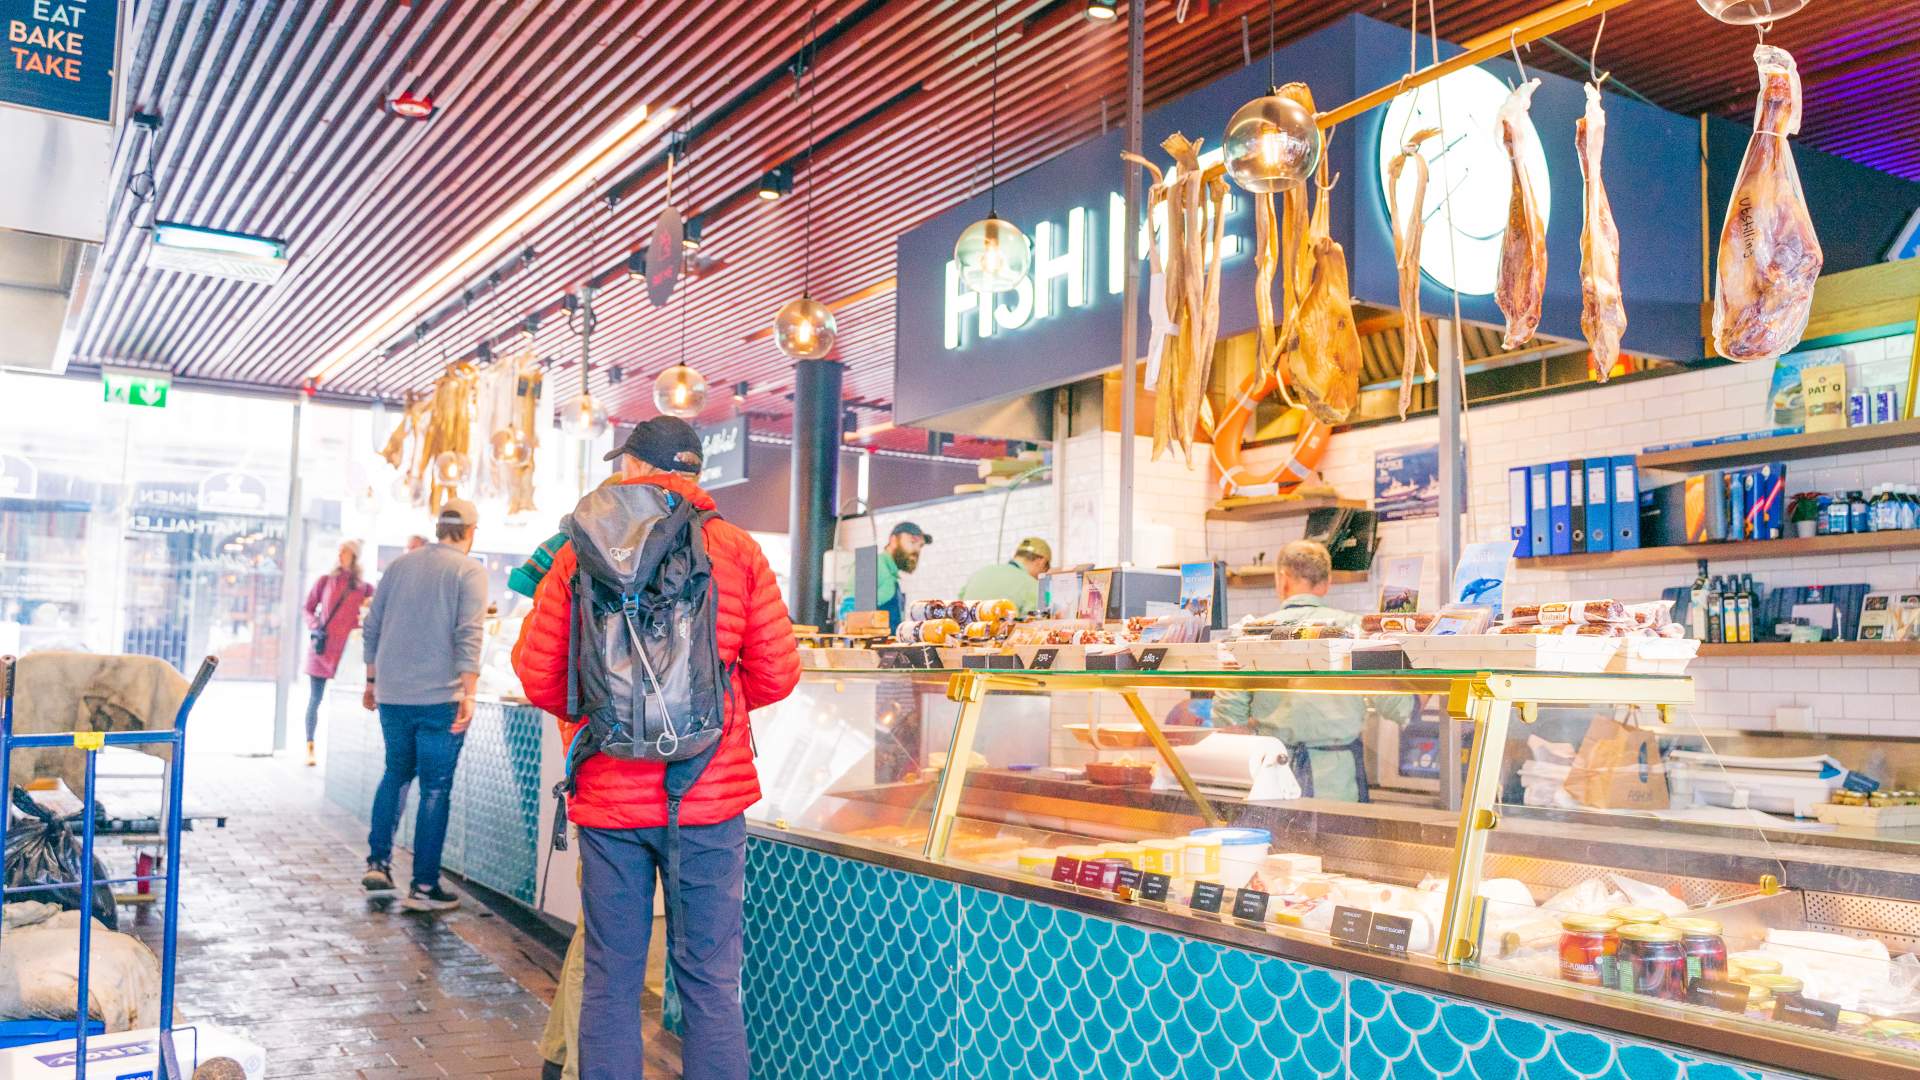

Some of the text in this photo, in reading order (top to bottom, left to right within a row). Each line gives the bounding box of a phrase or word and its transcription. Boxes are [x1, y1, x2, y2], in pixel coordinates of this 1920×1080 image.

[32, 0, 87, 28] EAT
[8, 19, 85, 56] BAKE
[10, 46, 82, 82] TAKE
